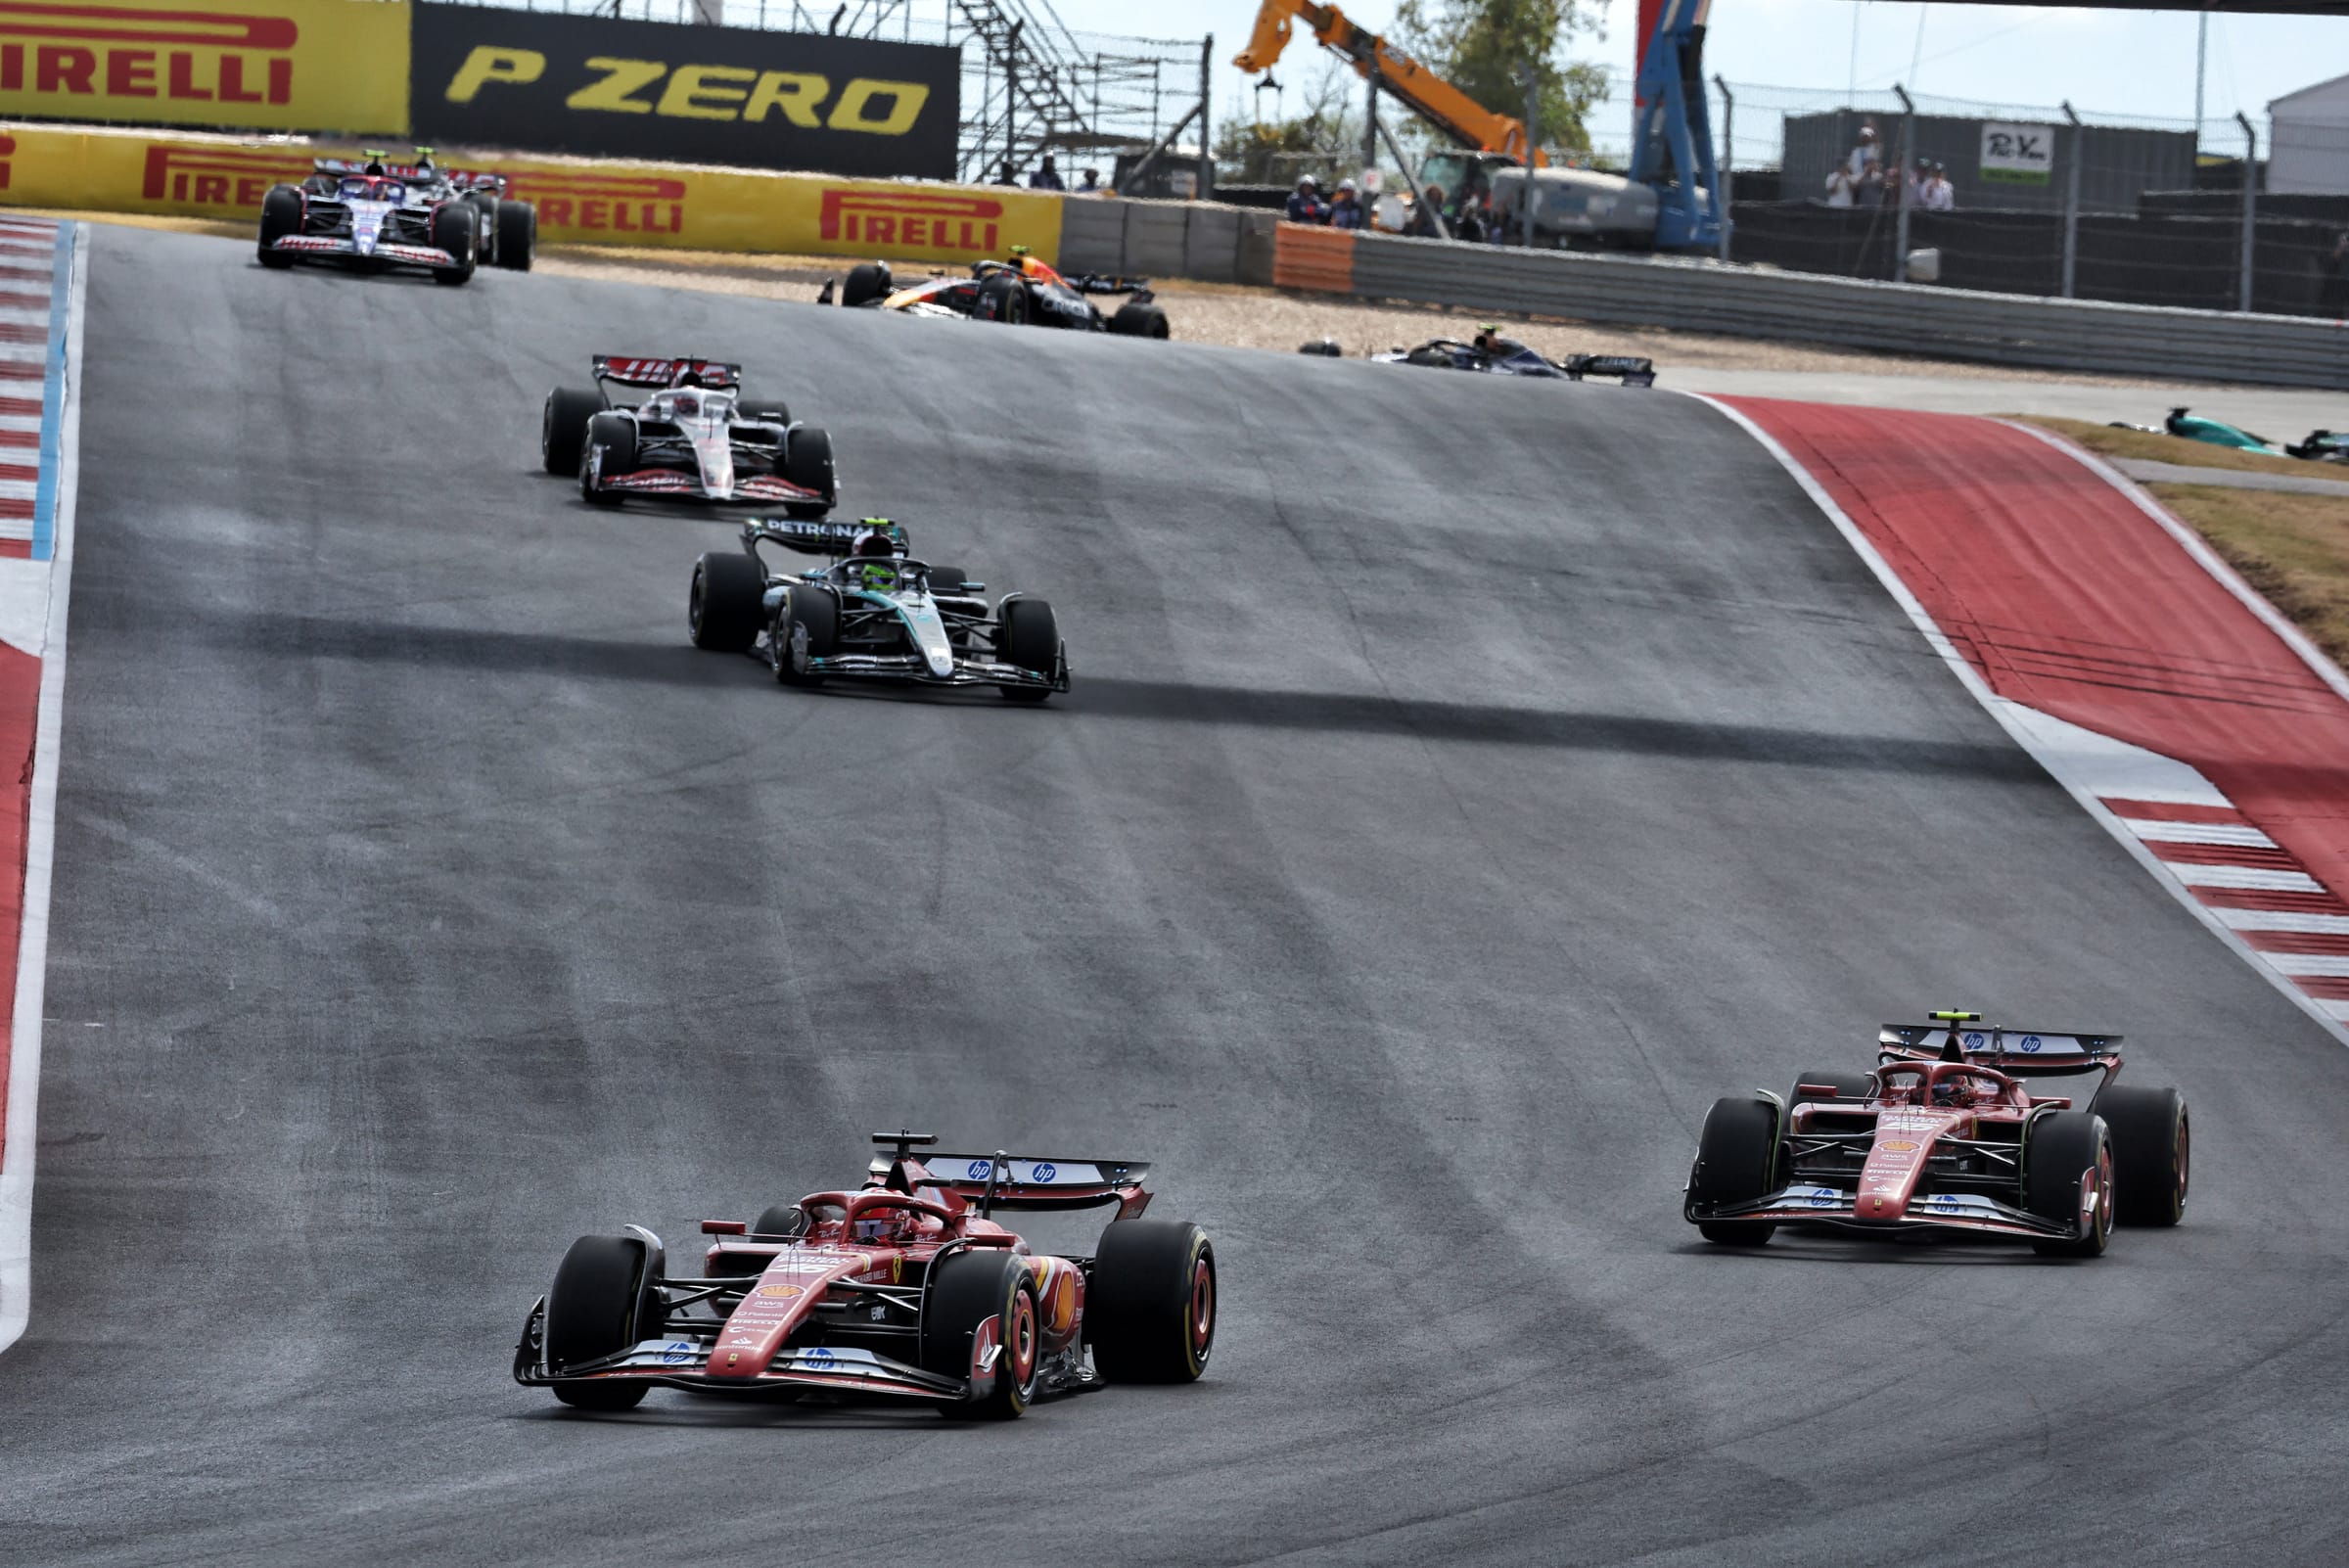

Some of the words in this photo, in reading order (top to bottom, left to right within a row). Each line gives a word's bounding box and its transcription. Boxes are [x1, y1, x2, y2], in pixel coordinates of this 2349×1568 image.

[445, 45, 547, 103] P
[566, 56, 930, 136] ZERO
[143, 146, 314, 207] PIRE
[820, 190, 1003, 252] PIRELLI
[1965, 1034, 1984, 1050] hp
[2022, 1036, 2041, 1053] hp
[971, 1161, 990, 1179] hp
[1035, 1163, 1055, 1182] hp
